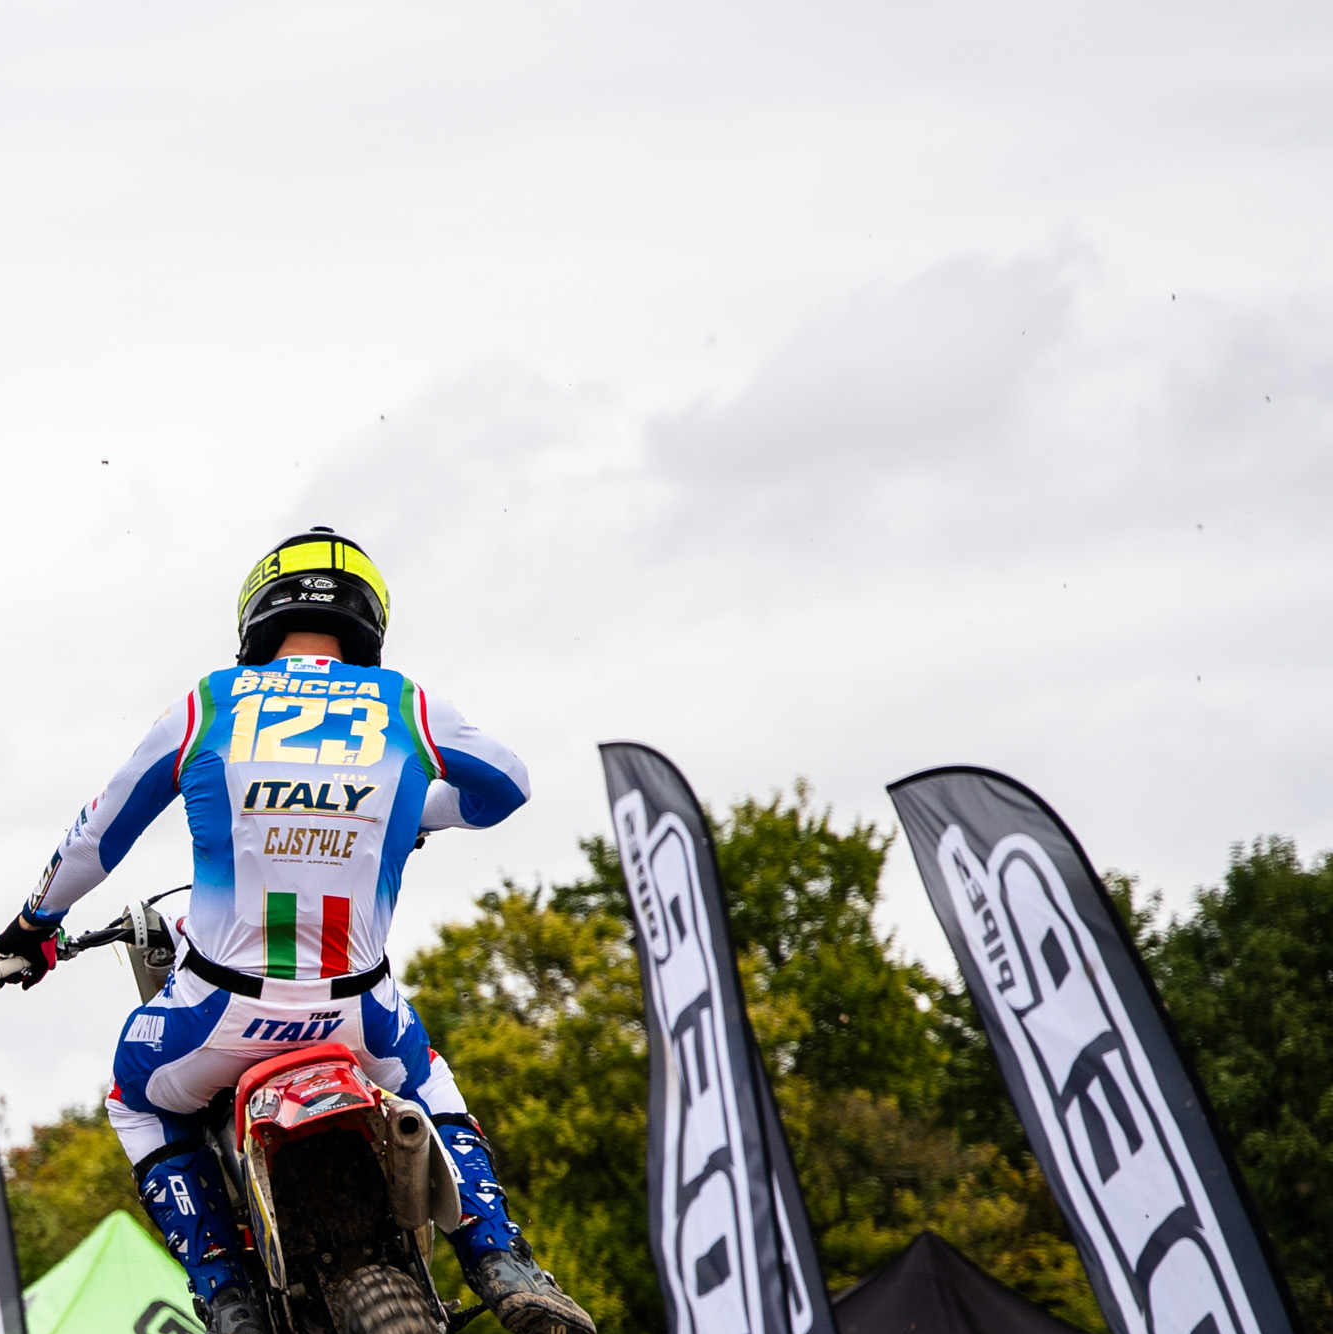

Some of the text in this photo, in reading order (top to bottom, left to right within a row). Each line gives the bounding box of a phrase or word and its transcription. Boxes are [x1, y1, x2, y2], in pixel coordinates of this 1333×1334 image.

[230, 675, 381, 699] BRICCA
[228, 693, 390, 768] 123
[333, 773, 368, 783] TEAM
[243, 779, 379, 813] ITALY
[263, 826, 359, 860] CJSTYLE
[309, 1010, 343, 1021] TEAM
[241, 1017, 345, 1042] ITALY
